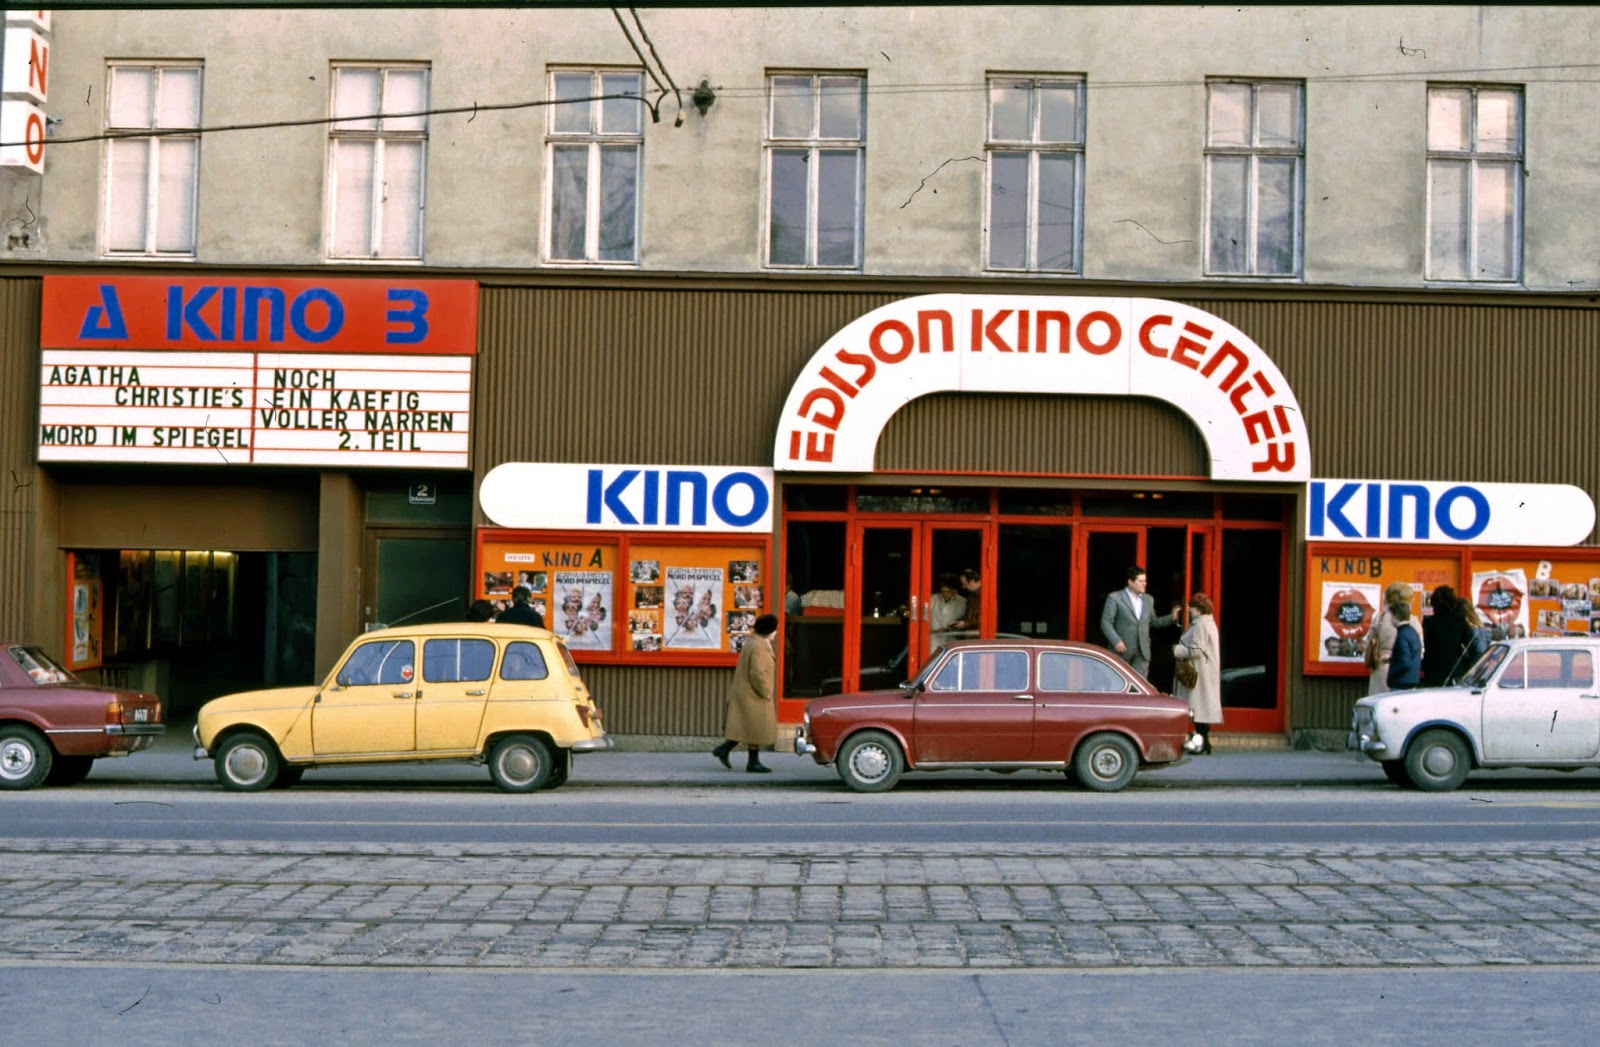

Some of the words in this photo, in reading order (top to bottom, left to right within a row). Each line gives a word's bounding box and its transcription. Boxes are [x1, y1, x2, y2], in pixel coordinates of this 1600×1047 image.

[79, 285, 129, 339] A
[166, 286, 345, 342] KINO
[49, 366, 141, 386] AGATHA
[274, 369, 335, 389] NOCH
[115, 387, 243, 408] CHRISTIE'S
[272, 390, 312, 409] EIN
[332, 390, 420, 411] KAEFIG
[790, 309, 954, 462] EDISON
[970, 309, 1122, 355] KINO
[1139, 314, 1295, 473] CENTER
[261, 409, 348, 429] VOLLER
[364, 411, 453, 431] NARREN
[41, 427, 97, 447] MORD
[112, 427, 137, 447] IM
[153, 428, 249, 448] SPIEGEL
[368, 432, 422, 451] TEIL
[417, 484, 428, 496] 2
[587, 469, 769, 527] KINO
[1309, 482, 1490, 540] KINO
[542, 552, 582, 567] KINO
[589, 547, 602, 568] A
[1321, 559, 1367, 575] KINO
[1370, 558, 1382, 577] B
